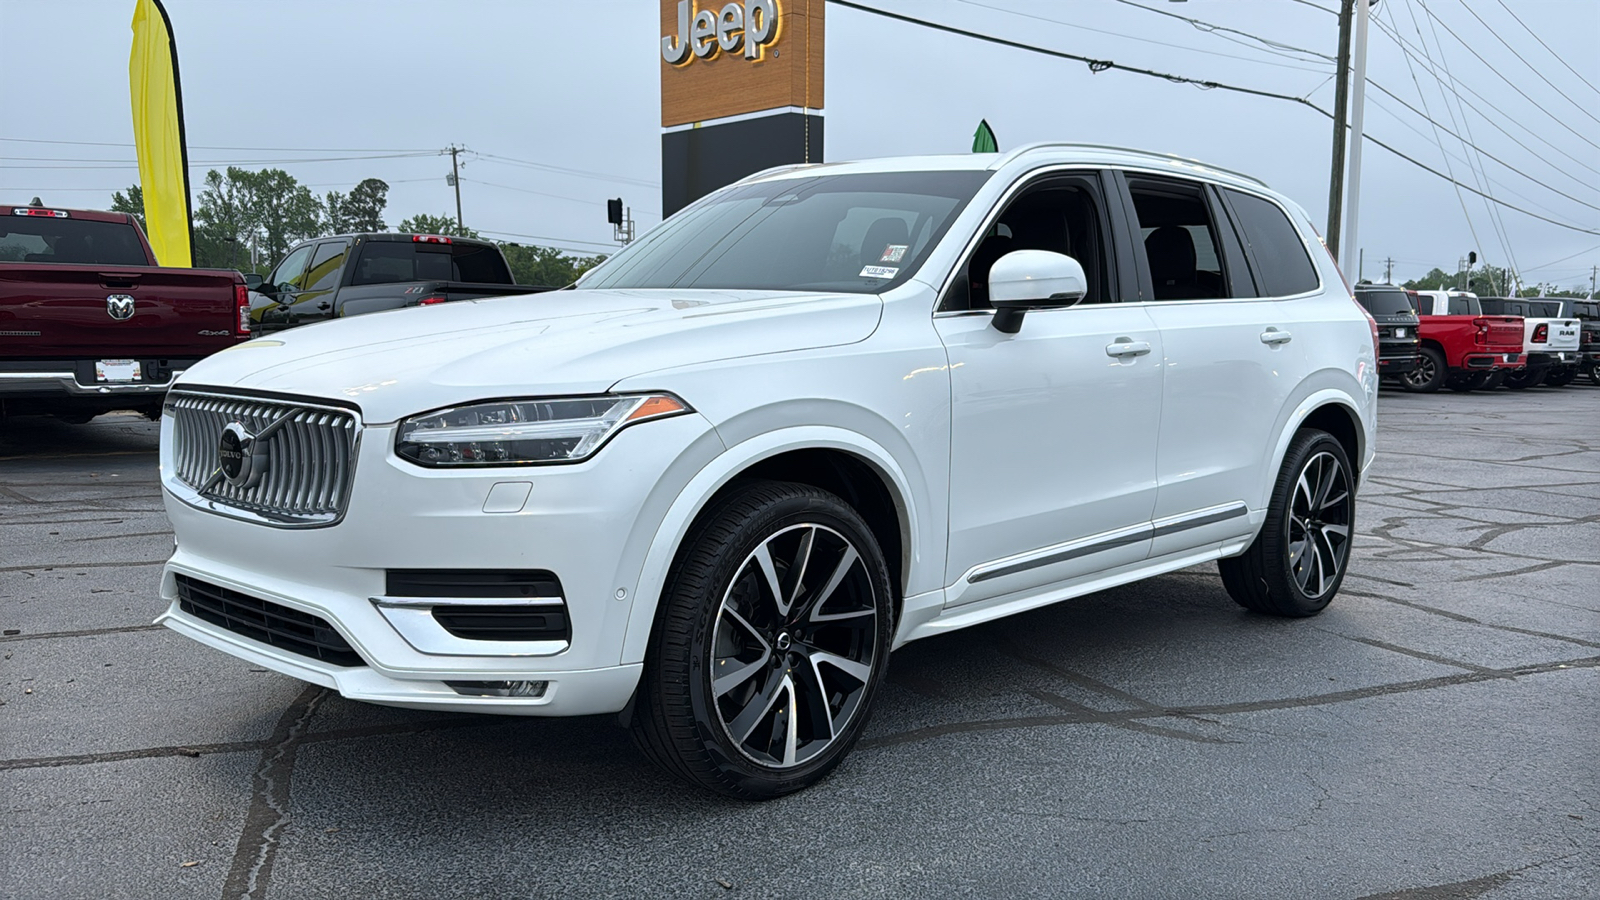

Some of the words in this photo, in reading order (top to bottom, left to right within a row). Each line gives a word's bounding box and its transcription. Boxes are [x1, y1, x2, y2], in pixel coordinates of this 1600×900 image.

[661, 0, 778, 65] Jeep
[404, 286, 424, 294] Z71
[219, 449, 242, 460] VOLVO
